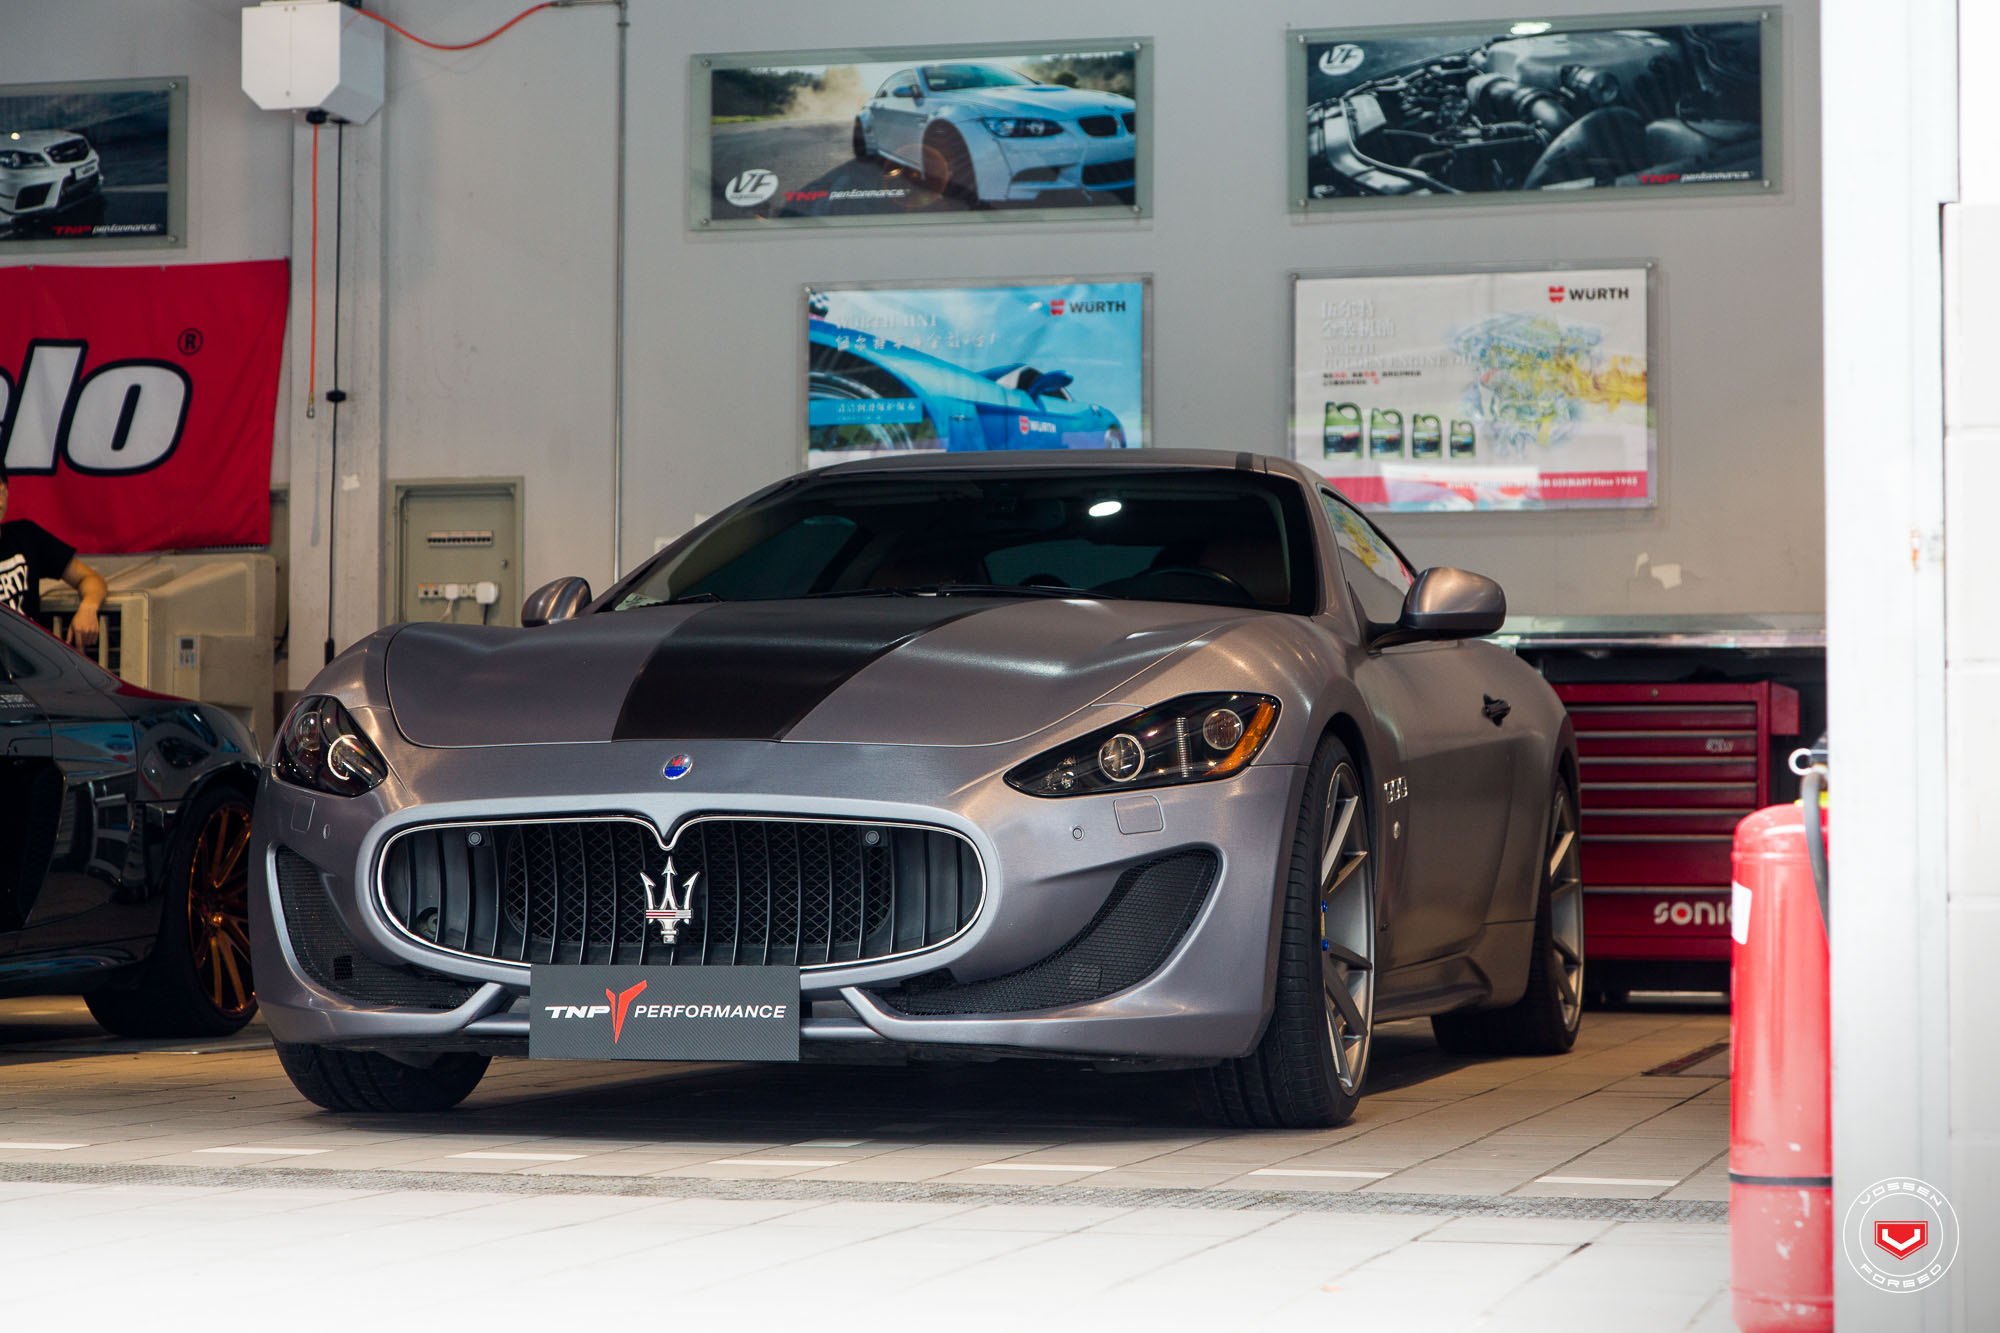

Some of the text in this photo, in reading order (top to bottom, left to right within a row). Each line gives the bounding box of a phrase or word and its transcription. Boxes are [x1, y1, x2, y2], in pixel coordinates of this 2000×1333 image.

[733, 171, 776, 194] VF
[782, 188, 905, 202] TNP performance
[52, 225, 92, 236] TNP
[1568, 286, 1629, 301] WÜRTH
[1069, 299, 1127, 315] WÜRTH
[0, 338, 193, 476] lo
[544, 1004, 787, 1019] TNP PERFORMANCE
